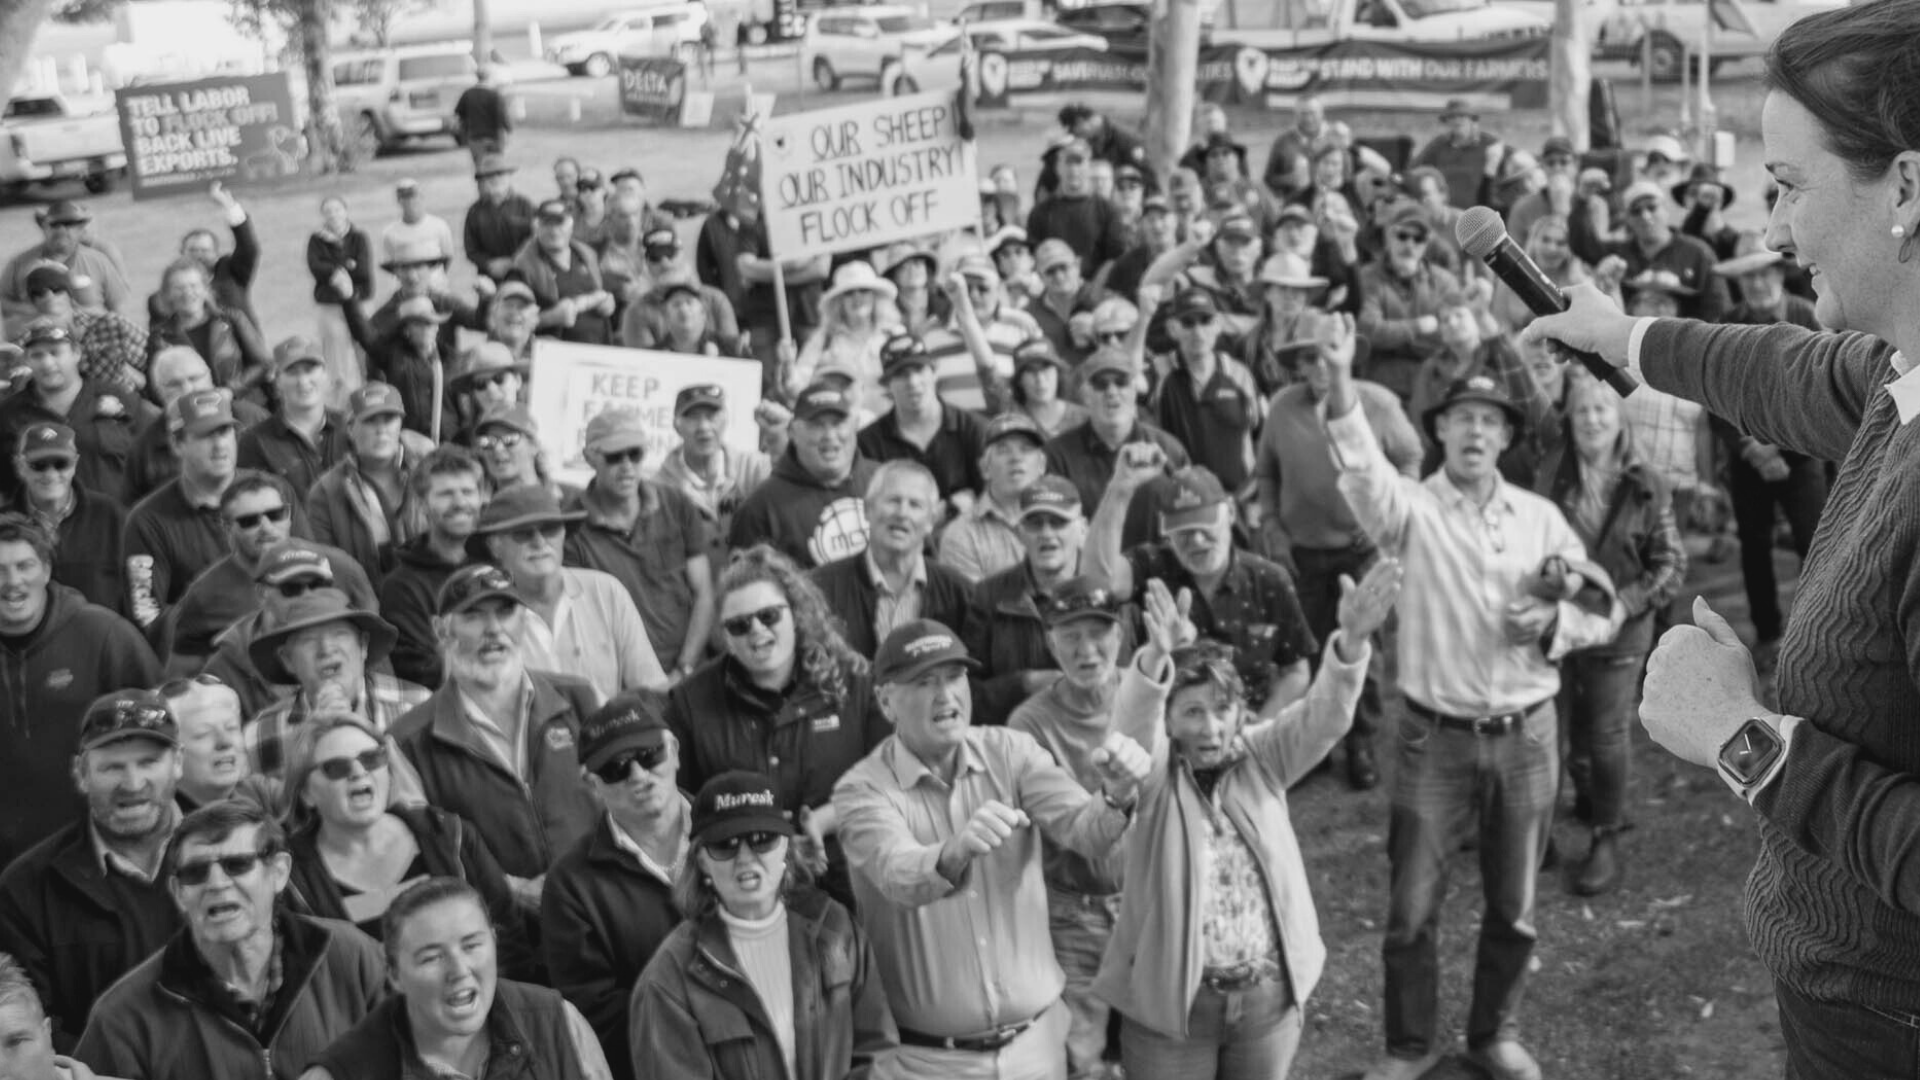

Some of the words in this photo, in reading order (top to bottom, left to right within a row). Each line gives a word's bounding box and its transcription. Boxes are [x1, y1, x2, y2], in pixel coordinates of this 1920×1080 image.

[624, 67, 668, 93] DELTA
[1320, 58, 1374, 80] STAND
[1376, 57, 1422, 80] WITH
[1425, 58, 1461, 79] OUR
[1465, 57, 1548, 81] FARMERS
[125, 93, 179, 117] TELL
[179, 85, 250, 114] LABOR
[129, 116, 160, 137] TO
[133, 131, 194, 156] BACK
[194, 125, 242, 148] LIVE
[811, 120, 861, 161] OUR
[873, 105, 946, 148] SHEEP
[137, 146, 239, 176] EXPORTS.
[779, 168, 830, 209] OUR
[799, 201, 880, 245] FLOCK
[890, 189, 939, 227] OFF
[591, 373, 660, 399] KEEP
[715, 788, 775, 812] Muresk
